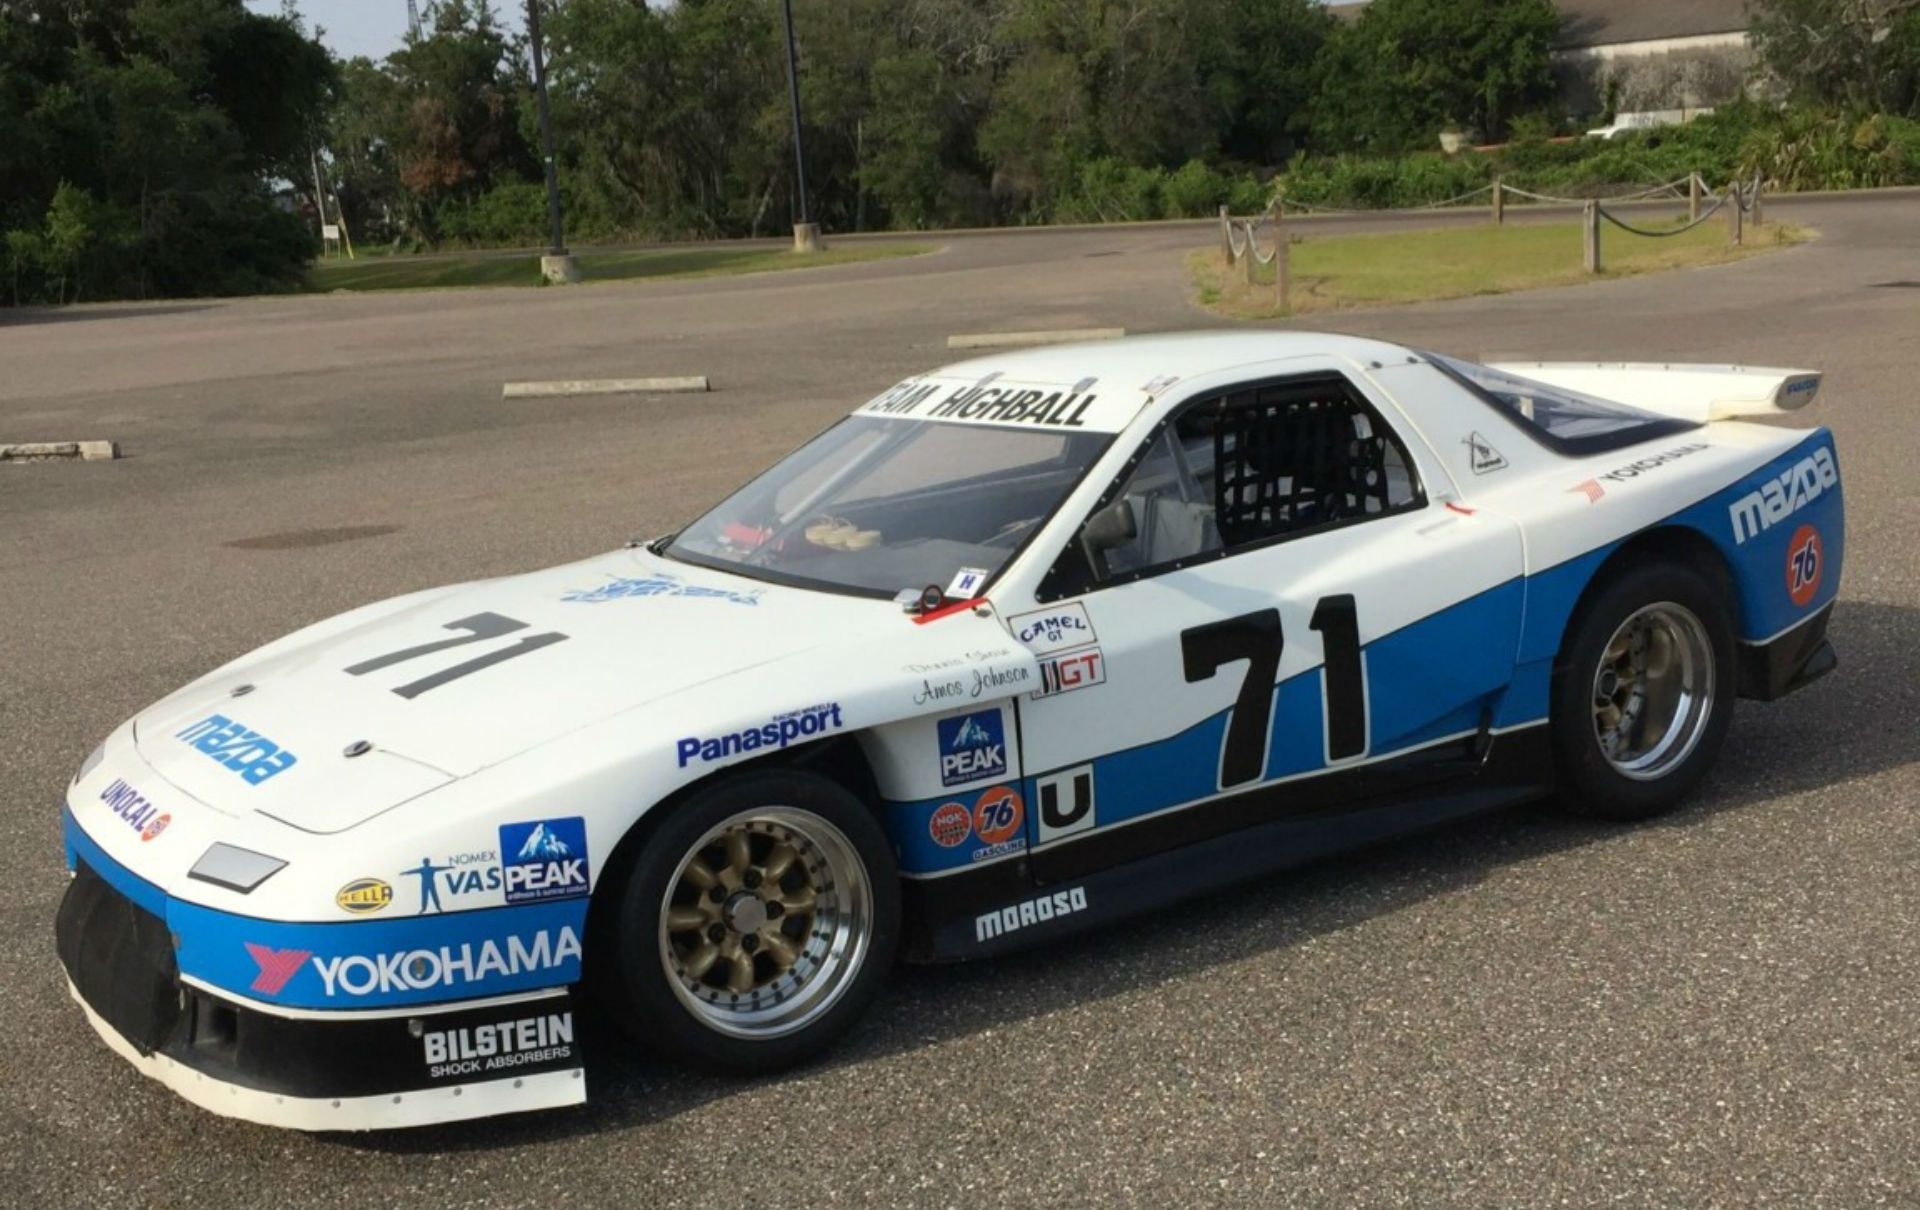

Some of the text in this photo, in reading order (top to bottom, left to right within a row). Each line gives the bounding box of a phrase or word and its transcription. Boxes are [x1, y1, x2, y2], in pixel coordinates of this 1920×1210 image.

[926, 386, 1098, 427] HIGHBALL
[1598, 443, 1711, 482] YOKOHAMA
[1728, 446, 1838, 546] mazda
[959, 574, 976, 590] H
[1791, 535, 1817, 594] 76
[1020, 615, 1087, 643] CAMEL
[1047, 631, 1063, 641] GT
[343, 611, 570, 700] 71
[1060, 653, 1099, 685] GT
[913, 664, 1029, 705] Amos Johnson
[1180, 593, 1370, 790] 71
[174, 714, 297, 786] mazda
[677, 702, 842, 768] Panasport
[942, 744, 1004, 777] PEAK
[100, 778, 157, 833] UNOCAL
[936, 812, 962, 826] NGK
[979, 794, 1016, 834] 76
[1040, 772, 1091, 829] U
[449, 851, 496, 866] NOMEX
[505, 858, 586, 892] PEAK
[339, 886, 392, 902] HELLA
[975, 886, 1088, 942] MOROSO
[313, 926, 582, 997] YOKOHAMA
[424, 1013, 574, 1065] BILSTEIN
[430, 1046, 571, 1078] SHOCK ABSORBERS
